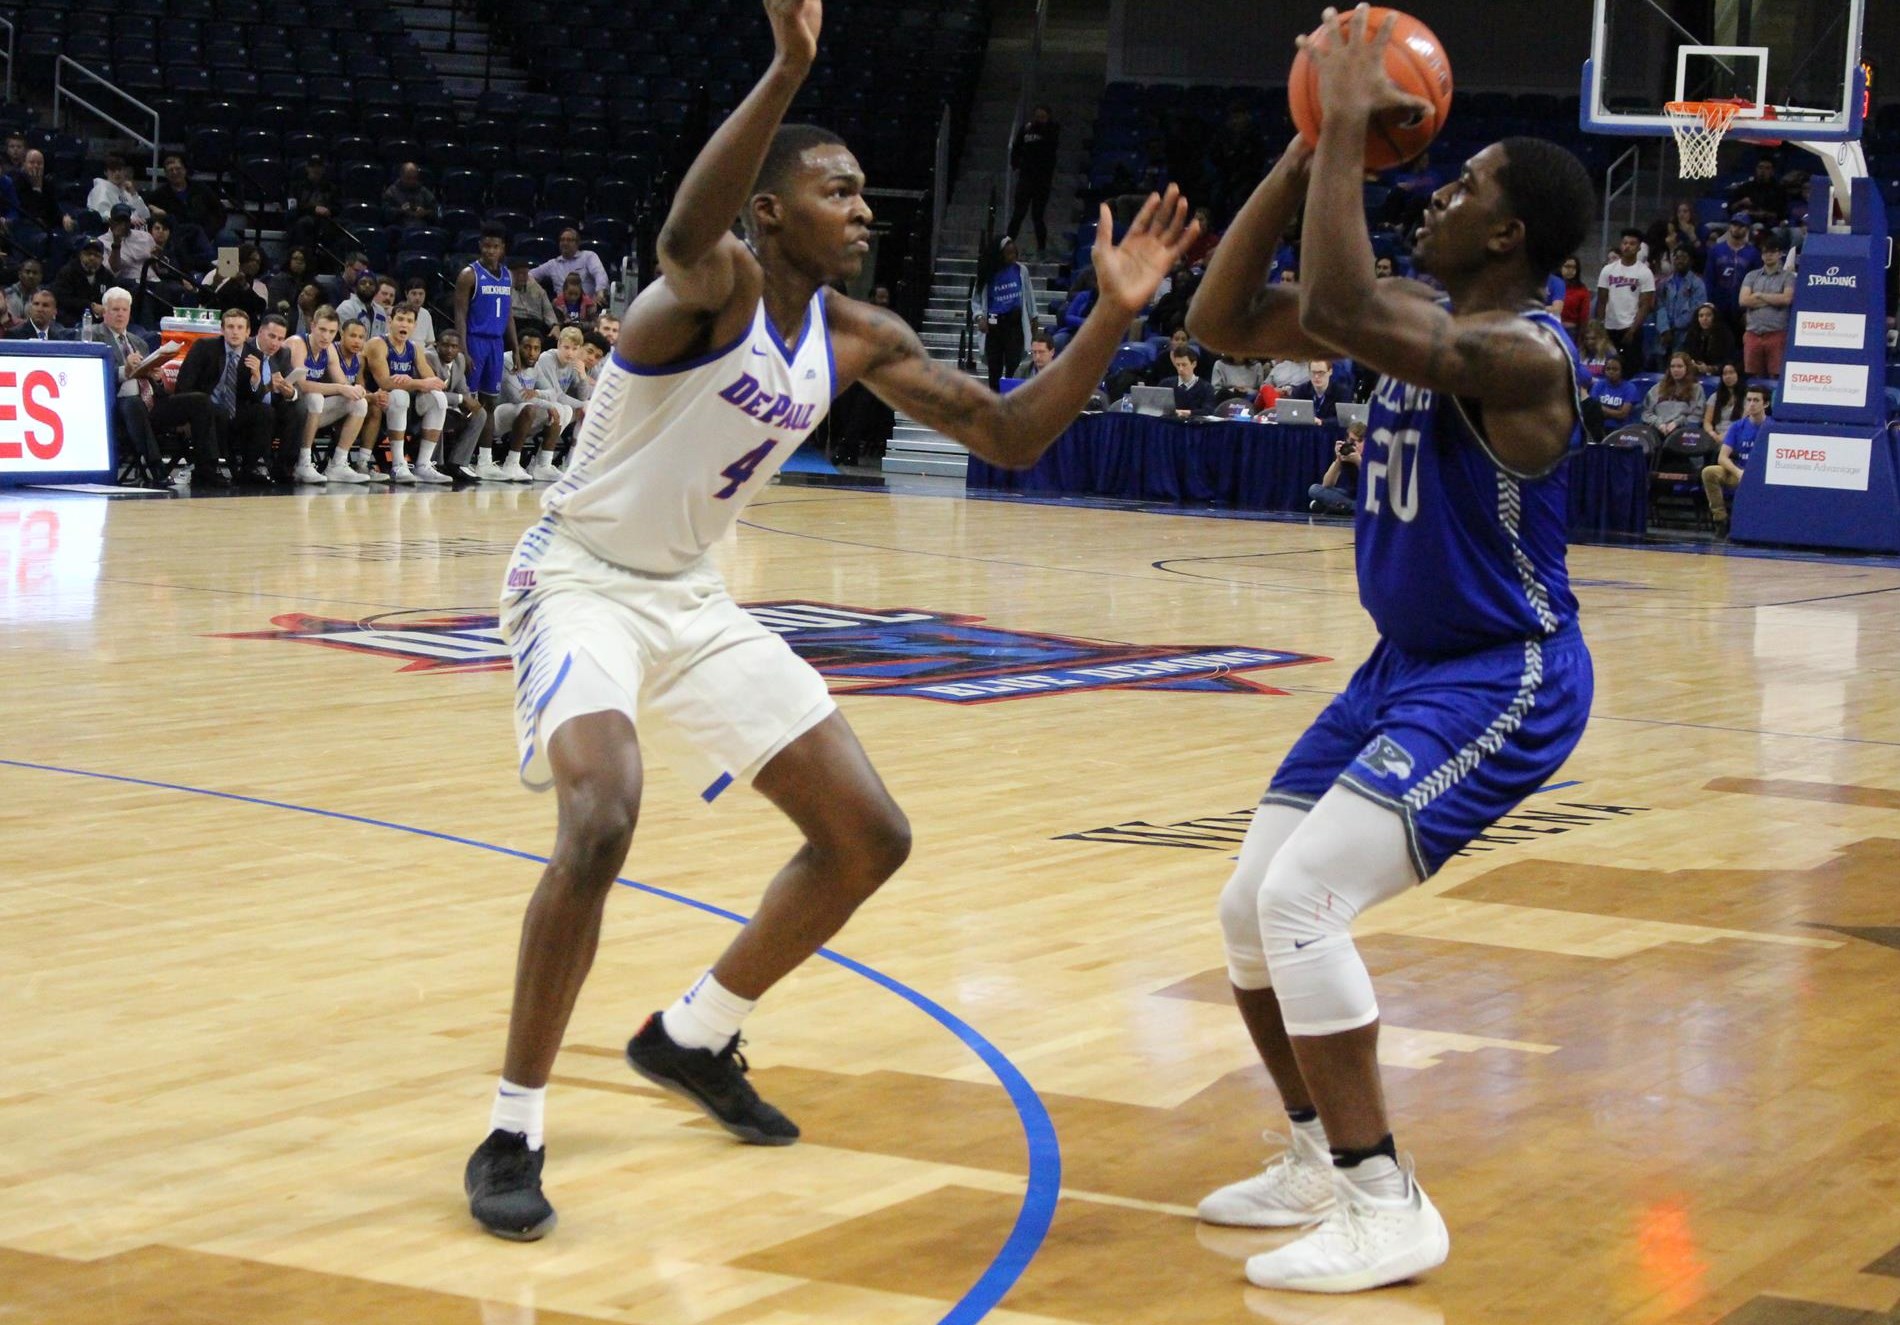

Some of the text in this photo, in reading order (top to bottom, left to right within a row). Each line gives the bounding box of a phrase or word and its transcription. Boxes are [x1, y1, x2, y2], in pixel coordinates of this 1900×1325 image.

[1808, 274, 1857, 288] SPALDING
[496, 297, 501, 318] 1
[1801, 321, 1836, 331] STAPLES
[1791, 373, 1832, 384] STAPLES
[1775, 447, 1826, 461] STAPLES
[712, 438, 779, 500] 4
[1365, 427, 1421, 523] 20
[912, 650, 1283, 698] BLUE DEMONS
